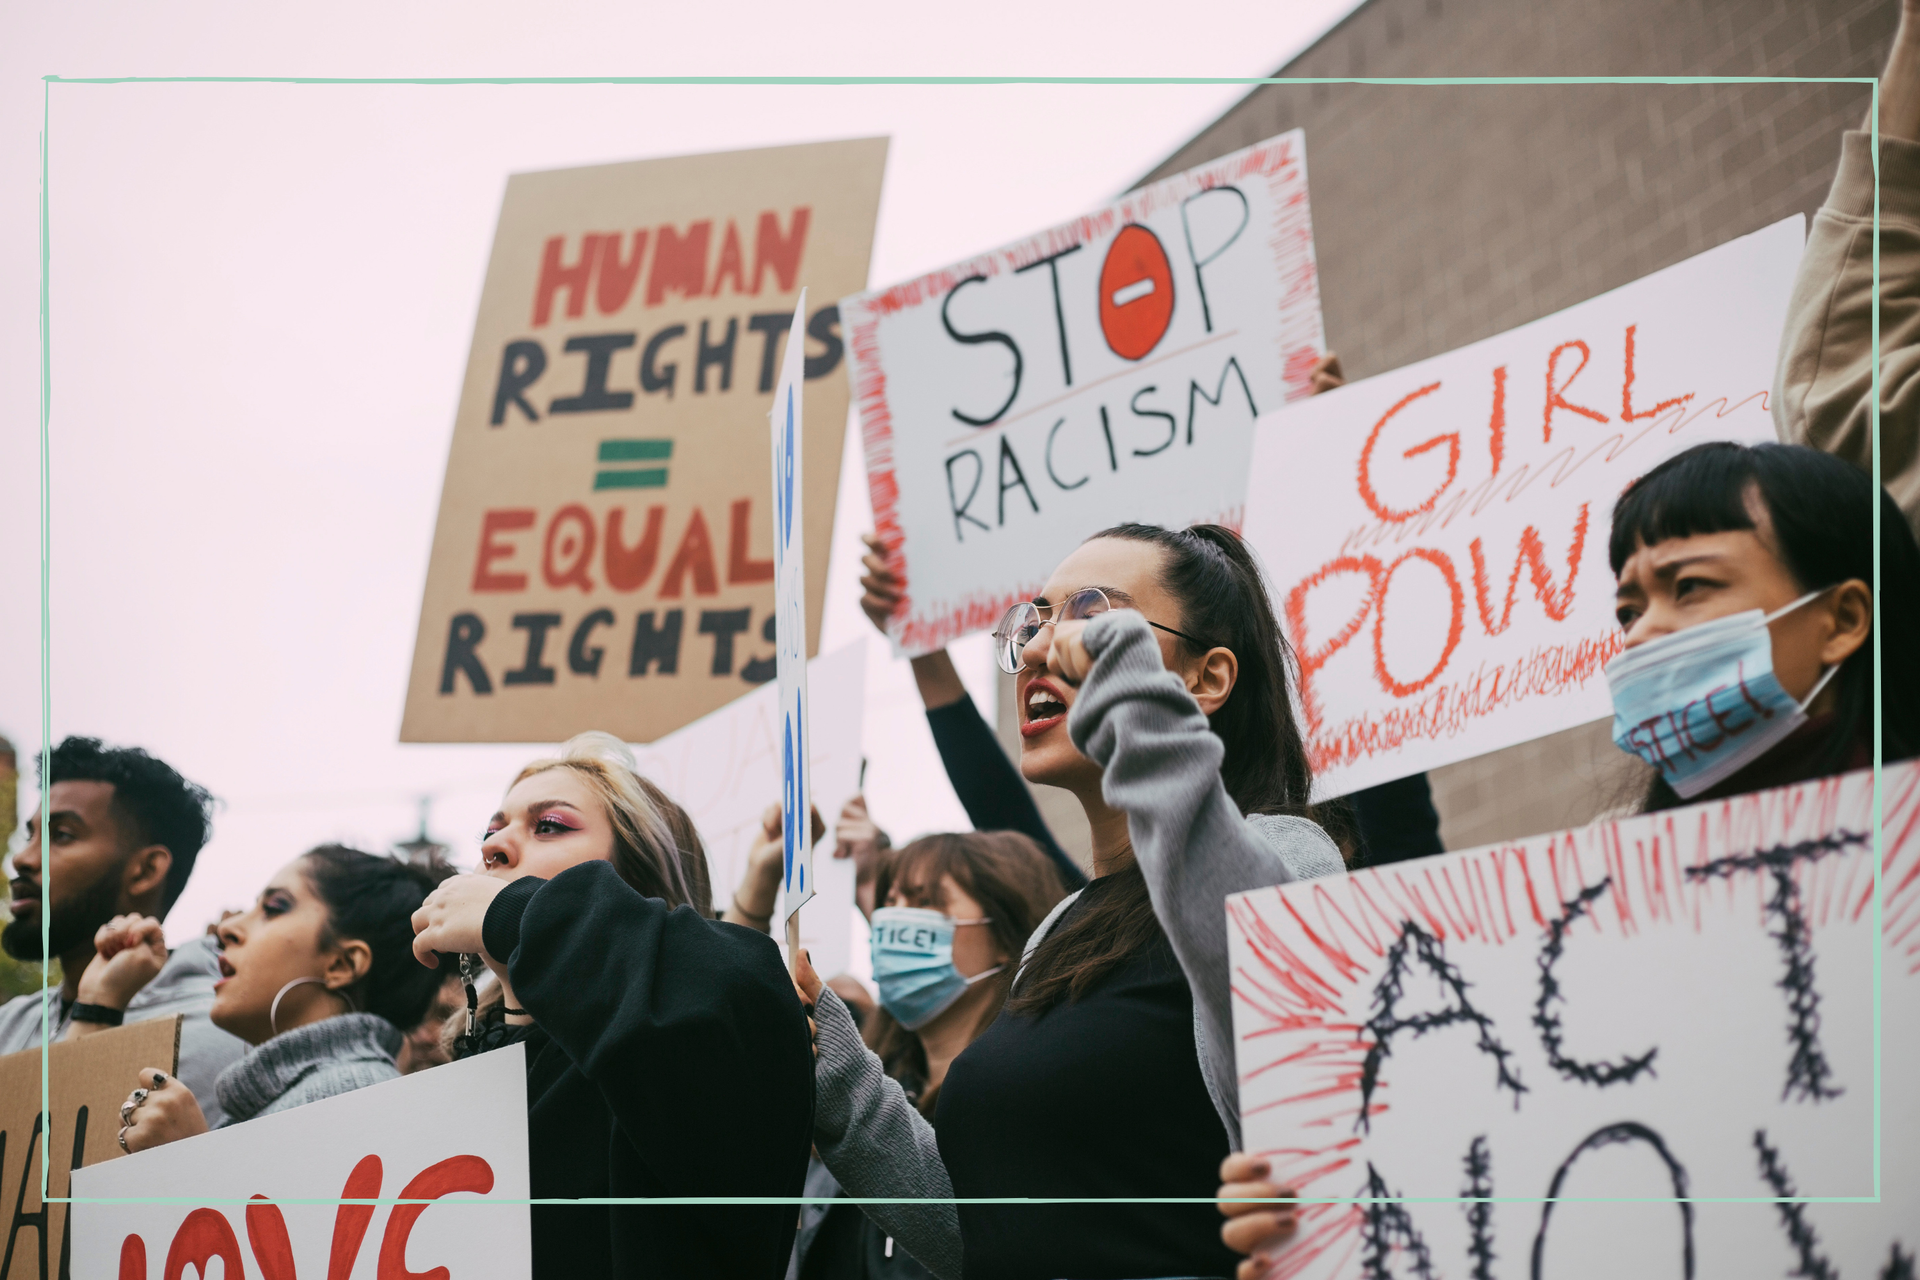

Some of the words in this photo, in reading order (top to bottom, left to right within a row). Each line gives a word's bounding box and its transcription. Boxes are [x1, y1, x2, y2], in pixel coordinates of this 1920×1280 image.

[532, 207, 811, 328] HUMAN
[943, 186, 1249, 426] STOP
[490, 305, 847, 427] RIGHTS
[945, 356, 1258, 542] RACISM
[1357, 324, 1696, 524] GIRL
[470, 498, 777, 600] EQUAL
[1352, 829, 1869, 1136] ACT
